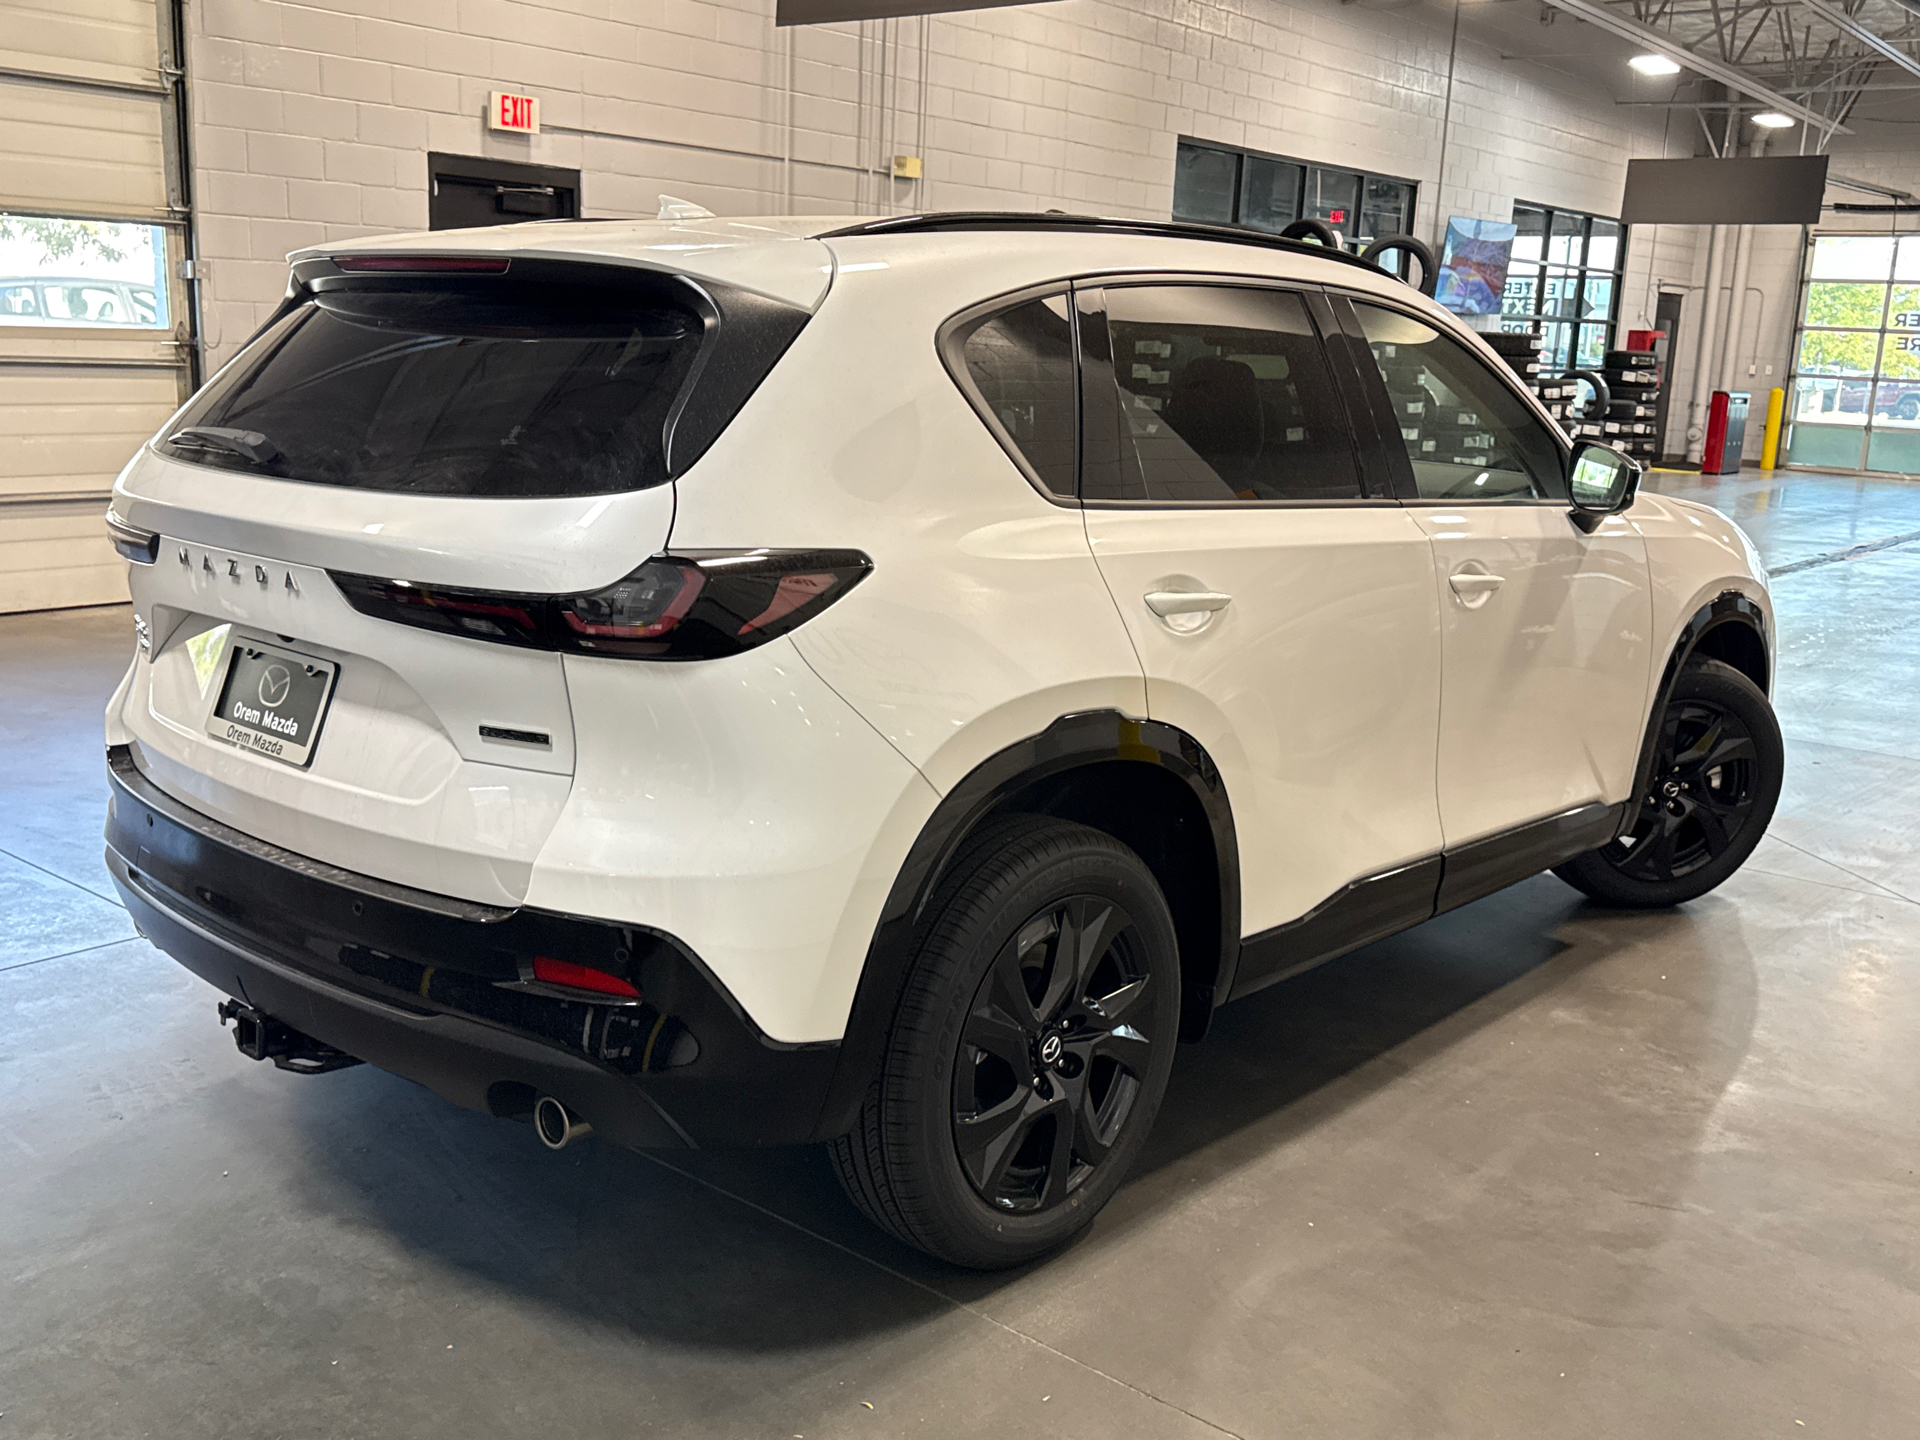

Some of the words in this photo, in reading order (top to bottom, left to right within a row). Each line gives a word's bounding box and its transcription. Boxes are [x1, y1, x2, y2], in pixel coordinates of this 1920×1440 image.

[501, 94, 534, 129] EXIT
[179, 546, 300, 590] MAZDA
[233, 701, 261, 725] Orem
[261, 710, 299, 736] Mazda
[226, 724, 252, 745] Orem
[251, 733, 284, 756] Mazda
